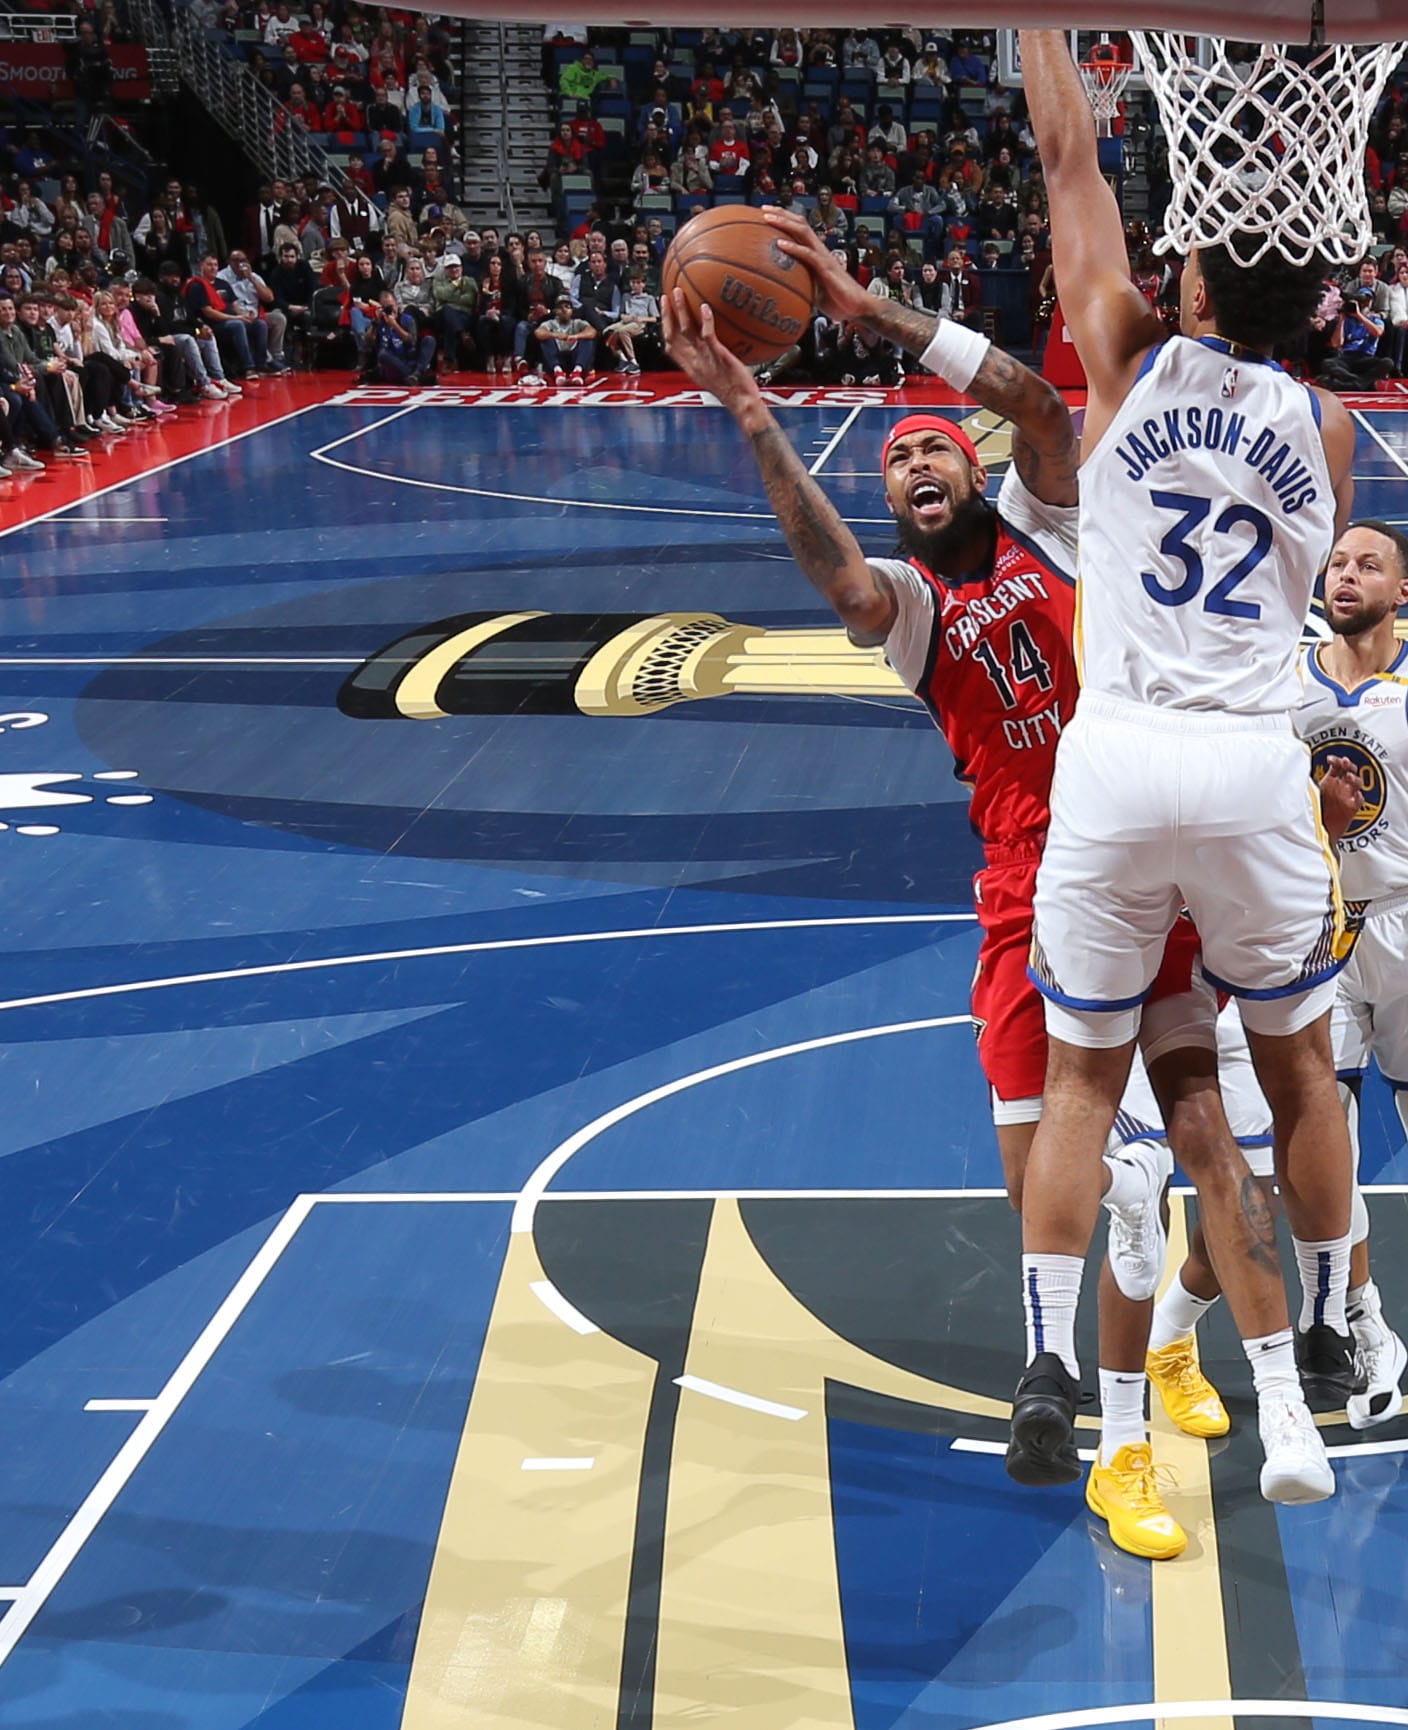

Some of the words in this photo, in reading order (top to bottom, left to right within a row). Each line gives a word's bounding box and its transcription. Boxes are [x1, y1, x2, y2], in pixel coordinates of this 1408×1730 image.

[720, 273, 803, 336] Wilson
[1115, 406, 1318, 515] JACKSON-DAVIS
[1140, 488, 1274, 621] 32
[971, 619, 1054, 710] 14
[1003, 701, 1061, 749] CITY
[1364, 697, 1401, 707] Rakuten
[1352, 729, 1388, 760] STATE
[1337, 817, 1390, 854] RIORS
